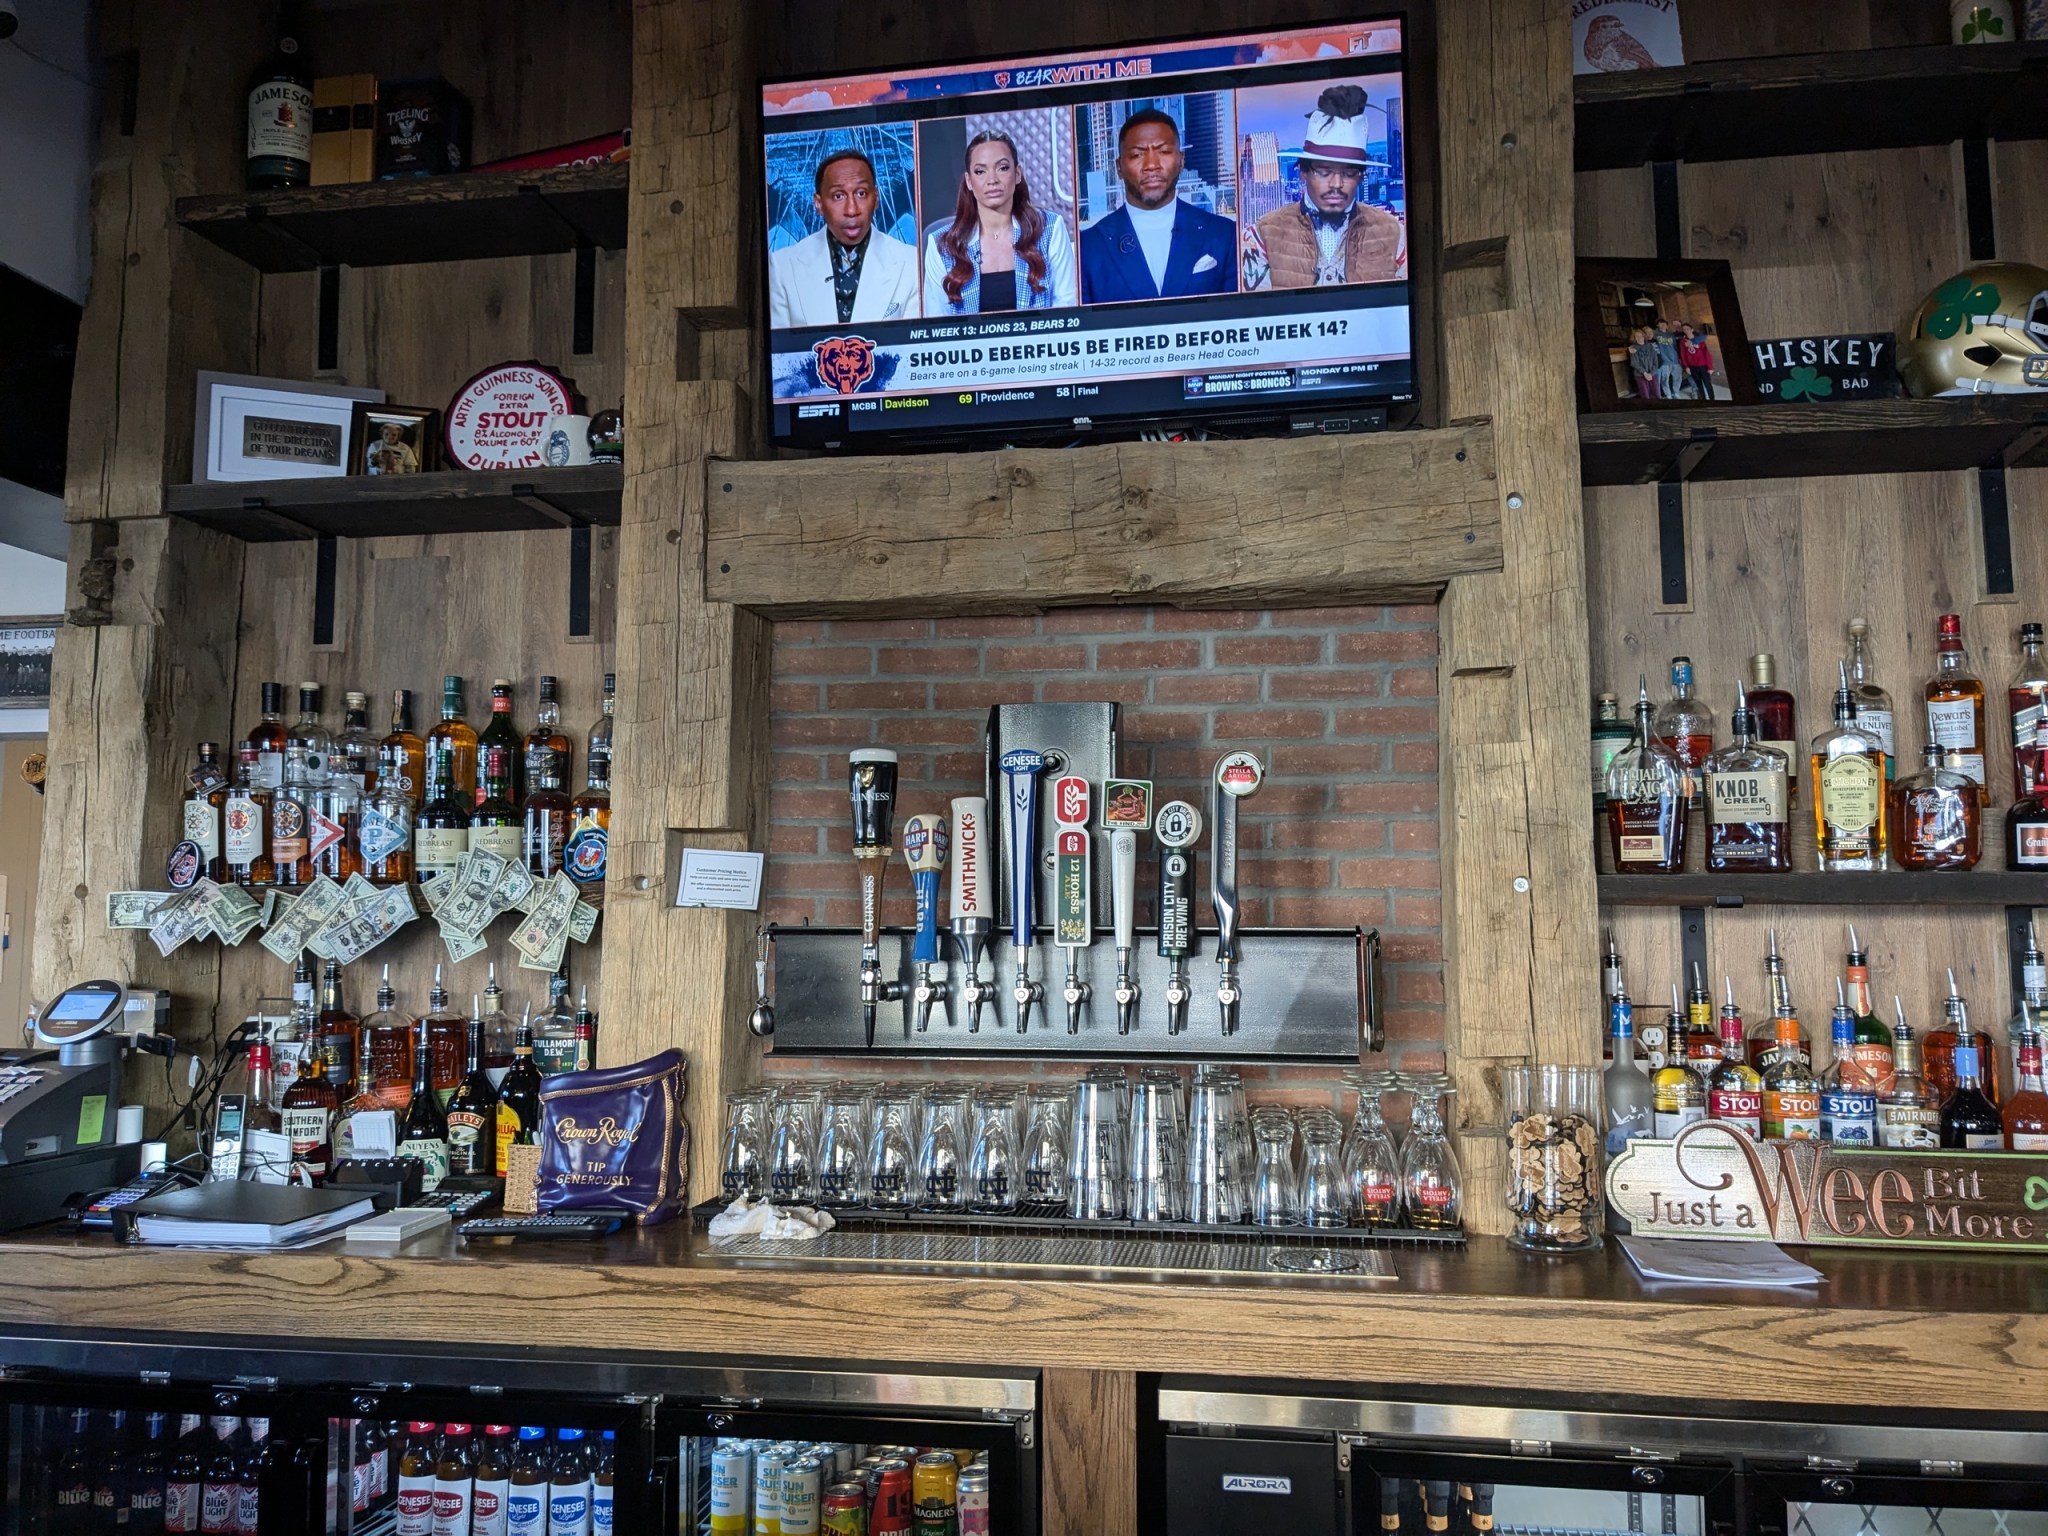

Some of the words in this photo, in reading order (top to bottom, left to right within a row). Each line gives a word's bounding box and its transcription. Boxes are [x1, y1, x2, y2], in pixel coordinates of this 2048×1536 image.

[1115, 58, 1152, 77] ME
[386, 107, 429, 126] TEELING
[390, 132, 423, 146] WHISKEY
[910, 329, 930, 340] NFL
[931, 327, 961, 338] WEEK
[962, 326, 977, 336] 13:
[979, 323, 1011, 335] LIONS
[1012, 322, 1028, 334] 23,
[1030, 320, 1065, 332] BEARS
[1066, 318, 1080, 328] 20
[910, 351, 983, 368] SHOULD
[988, 340, 1081, 363] EBERFLUS
[1086, 339, 1109, 355] BE
[1114, 333, 1170, 352] FIRED
[1175, 328, 1250, 348] BEFORE
[1255, 322, 1312, 341] WEEK
[1317, 320, 1348, 337] 14?
[1759, 338, 1884, 370] HISKEY
[910, 371, 937, 381] Bears
[940, 371, 954, 379] are
[957, 370, 970, 378] on
[980, 365, 1015, 378] 6-game
[1018, 363, 1047, 376] losing
[1049, 361, 1079, 373] streak
[1089, 356, 1116, 368] 14-32
[1118, 353, 1150, 366] record
[1153, 354, 1165, 363] as
[1167, 351, 1196, 363] Bears
[1198, 349, 1224, 361] Head
[1227, 347, 1260, 359] Coach
[1301, 366, 1340, 376] MONDAY
[1351, 364, 1366, 373] PM
[1367, 363, 1379, 371] ET
[1208, 373, 1234, 381] MONDAY
[1236, 371, 1254, 379] NIGHT
[1255, 369, 1288, 378] FOOTBALL
[473, 371, 534, 396] GUINNESS
[535, 377, 556, 398] SON
[1205, 379, 1243, 393] BROWNS
[1250, 376, 1291, 391] BRONCOS
[1842, 377, 1869, 390] BAD
[493, 393, 534, 401] FOREIGN
[798, 404, 840, 418] ESPN
[852, 402, 877, 411] MCBB
[884, 397, 929, 409] Davidson
[959, 394, 973, 404] 69
[980, 391, 1035, 403] Providence
[1056, 387, 1070, 397] 58
[1077, 386, 1099, 396] Final
[477, 411, 548, 429] STOUT
[251, 433, 262, 441] IN
[264, 433, 281, 443] THE
[284, 435, 334, 448] DIRECTION
[489, 430, 529, 438] ALCOHOL
[474, 438, 508, 447] VOLUME
[251, 443, 265, 452] OF
[266, 444, 291, 455] YOUR
[294, 447, 336, 460] DREAMS
[468, 450, 541, 471] DUBLIN
[1931, 710, 1971, 721] Dewar's
[1950, 724, 1969, 732] Label
[2015, 718, 2038, 730] BLACK
[1002, 756, 1041, 766] GENESEE
[1620, 768, 1660, 781] ELIJAH
[1716, 779, 1759, 798] KNOB
[850, 792, 890, 802] GUINNESS
[1765, 803, 1772, 816] 9
[1160, 811, 1169, 831] PRISON
[1168, 806, 1179, 814] CITY
[1179, 806, 1193, 828] BREWING
[417, 839, 454, 847] REDBREAST
[475, 838, 515, 846] REDBREAST
[905, 832, 927, 846] HARP
[428, 854, 437, 862] 15
[1070, 858, 1080, 872] 12
[1070, 873, 1080, 914] HORSE
[1164, 882, 1174, 905] CITY
[864, 875, 875, 933] GUINNESS
[916, 889, 925, 933] HARP
[1163, 908, 1174, 947] PRISON
[1176, 897, 1188, 948] BREWING
[283, 1049, 297, 1061] BEA
[544, 1048, 564, 1056] D.E.W.
[1719, 1096, 1760, 1111] STOLI
[1780, 1098, 1820, 1112] STOLI
[1829, 1098, 1874, 1113] STOLI
[284, 1116, 324, 1126] SOUTHERN
[449, 1114, 481, 1124] AILEYS
[285, 1127, 320, 1137] COMFORT
[555, 1118, 598, 1143] Crown
[587, 1117, 642, 1146] Royal
[405, 1142, 440, 1150] NUYENS
[1835, 1137, 1871, 1146] BLUEBERRY
[587, 1162, 606, 1172] TIP
[556, 1174, 634, 1186] GENEROUSLY
[1648, 1191, 1723, 1227] Just
[1736, 1203, 1757, 1228] a
[1921, 1165, 1988, 1200] Bit
[1924, 1203, 2035, 1239] More
[783, 1480, 804, 1491] SUN
[1225, 1478, 1289, 1490] AURORA
[58, 1487, 91, 1505] Blue
[132, 1491, 163, 1509] Blue
[205, 1497, 228, 1507] Blue
[398, 1494, 431, 1507] GENESEE
[205, 1507, 227, 1516] LIGHT
[551, 1500, 585, 1514] GENESEE
[914, 1506, 955, 1518] MAGNERS
